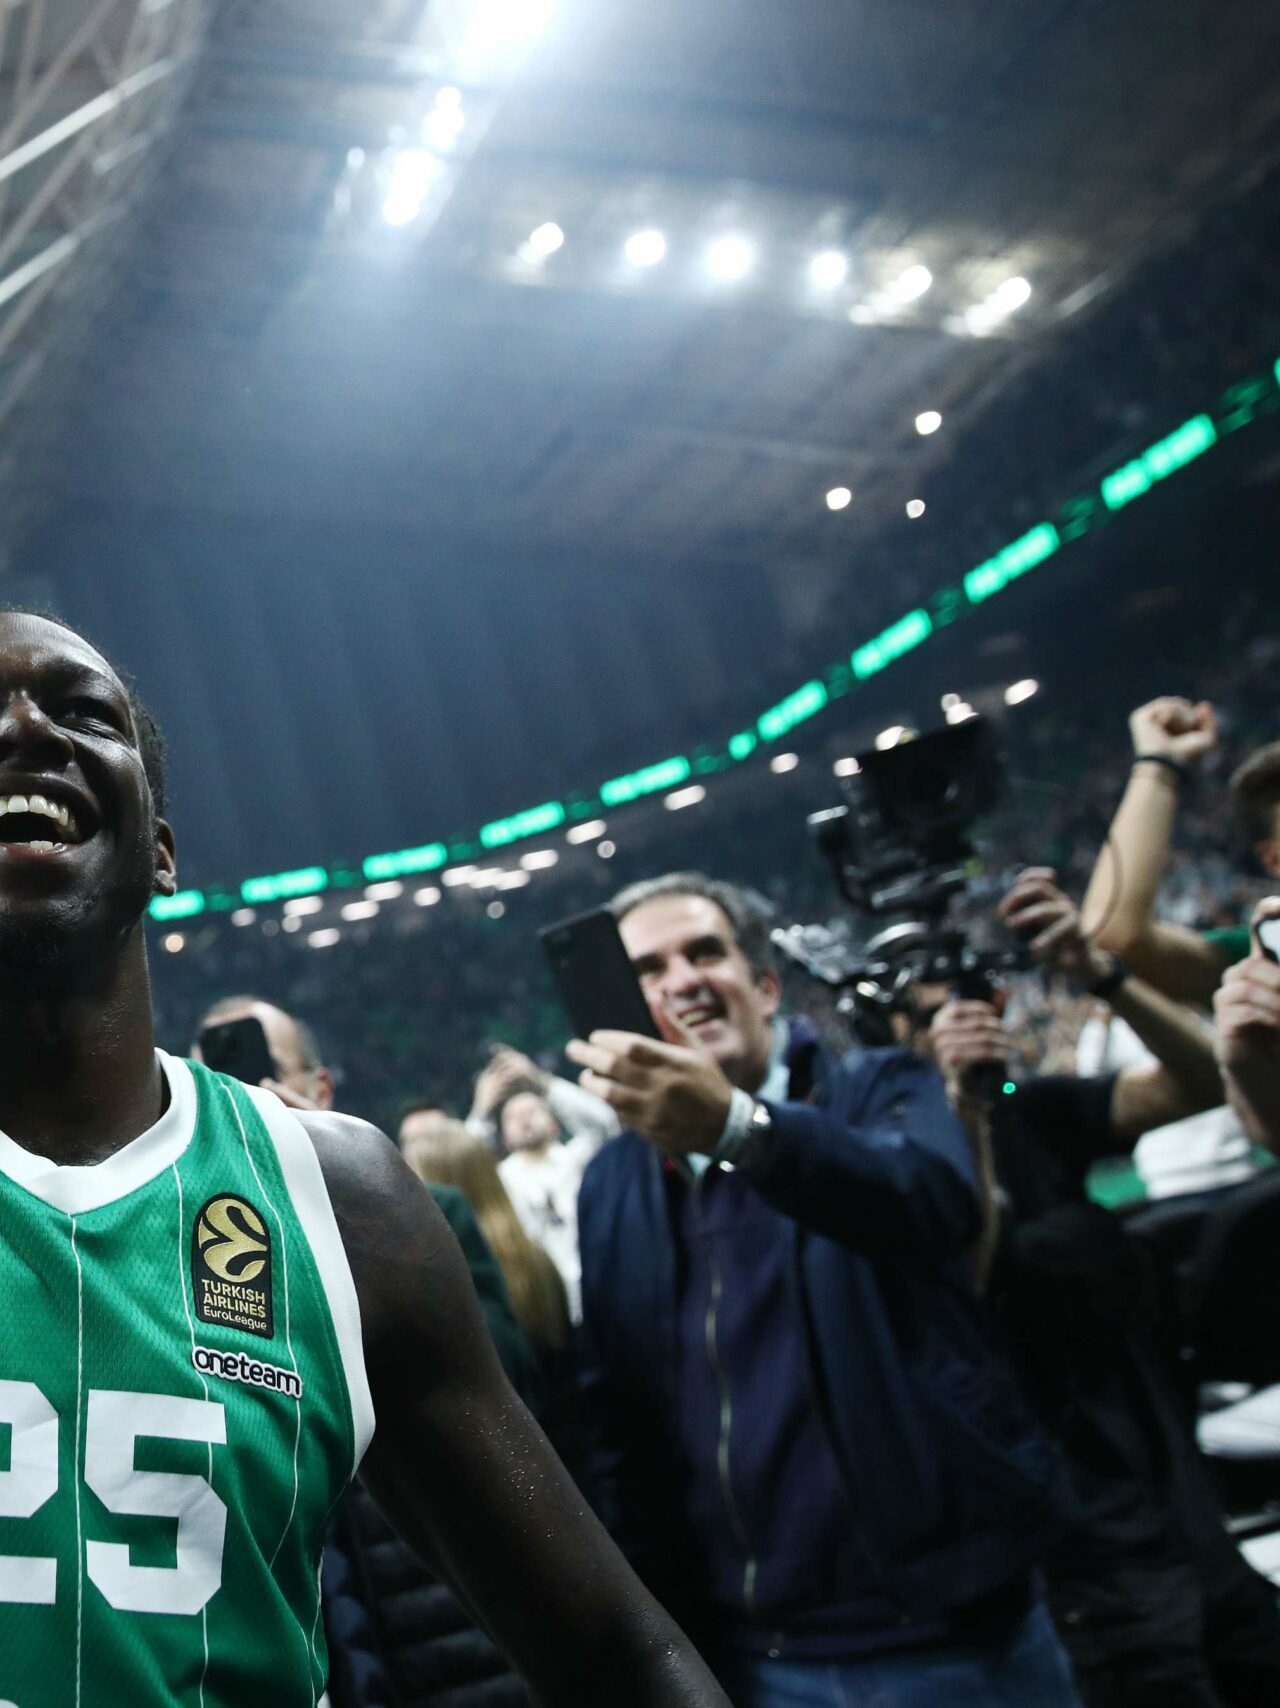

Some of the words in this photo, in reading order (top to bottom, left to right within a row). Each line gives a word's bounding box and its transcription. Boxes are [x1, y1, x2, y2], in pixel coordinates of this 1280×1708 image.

[202, 1279, 265, 1304] TURKISH
[203, 1293, 266, 1318] AIRLINES
[203, 1306, 267, 1330] EuroLeague
[194, 1348, 301, 1396] oneteam
